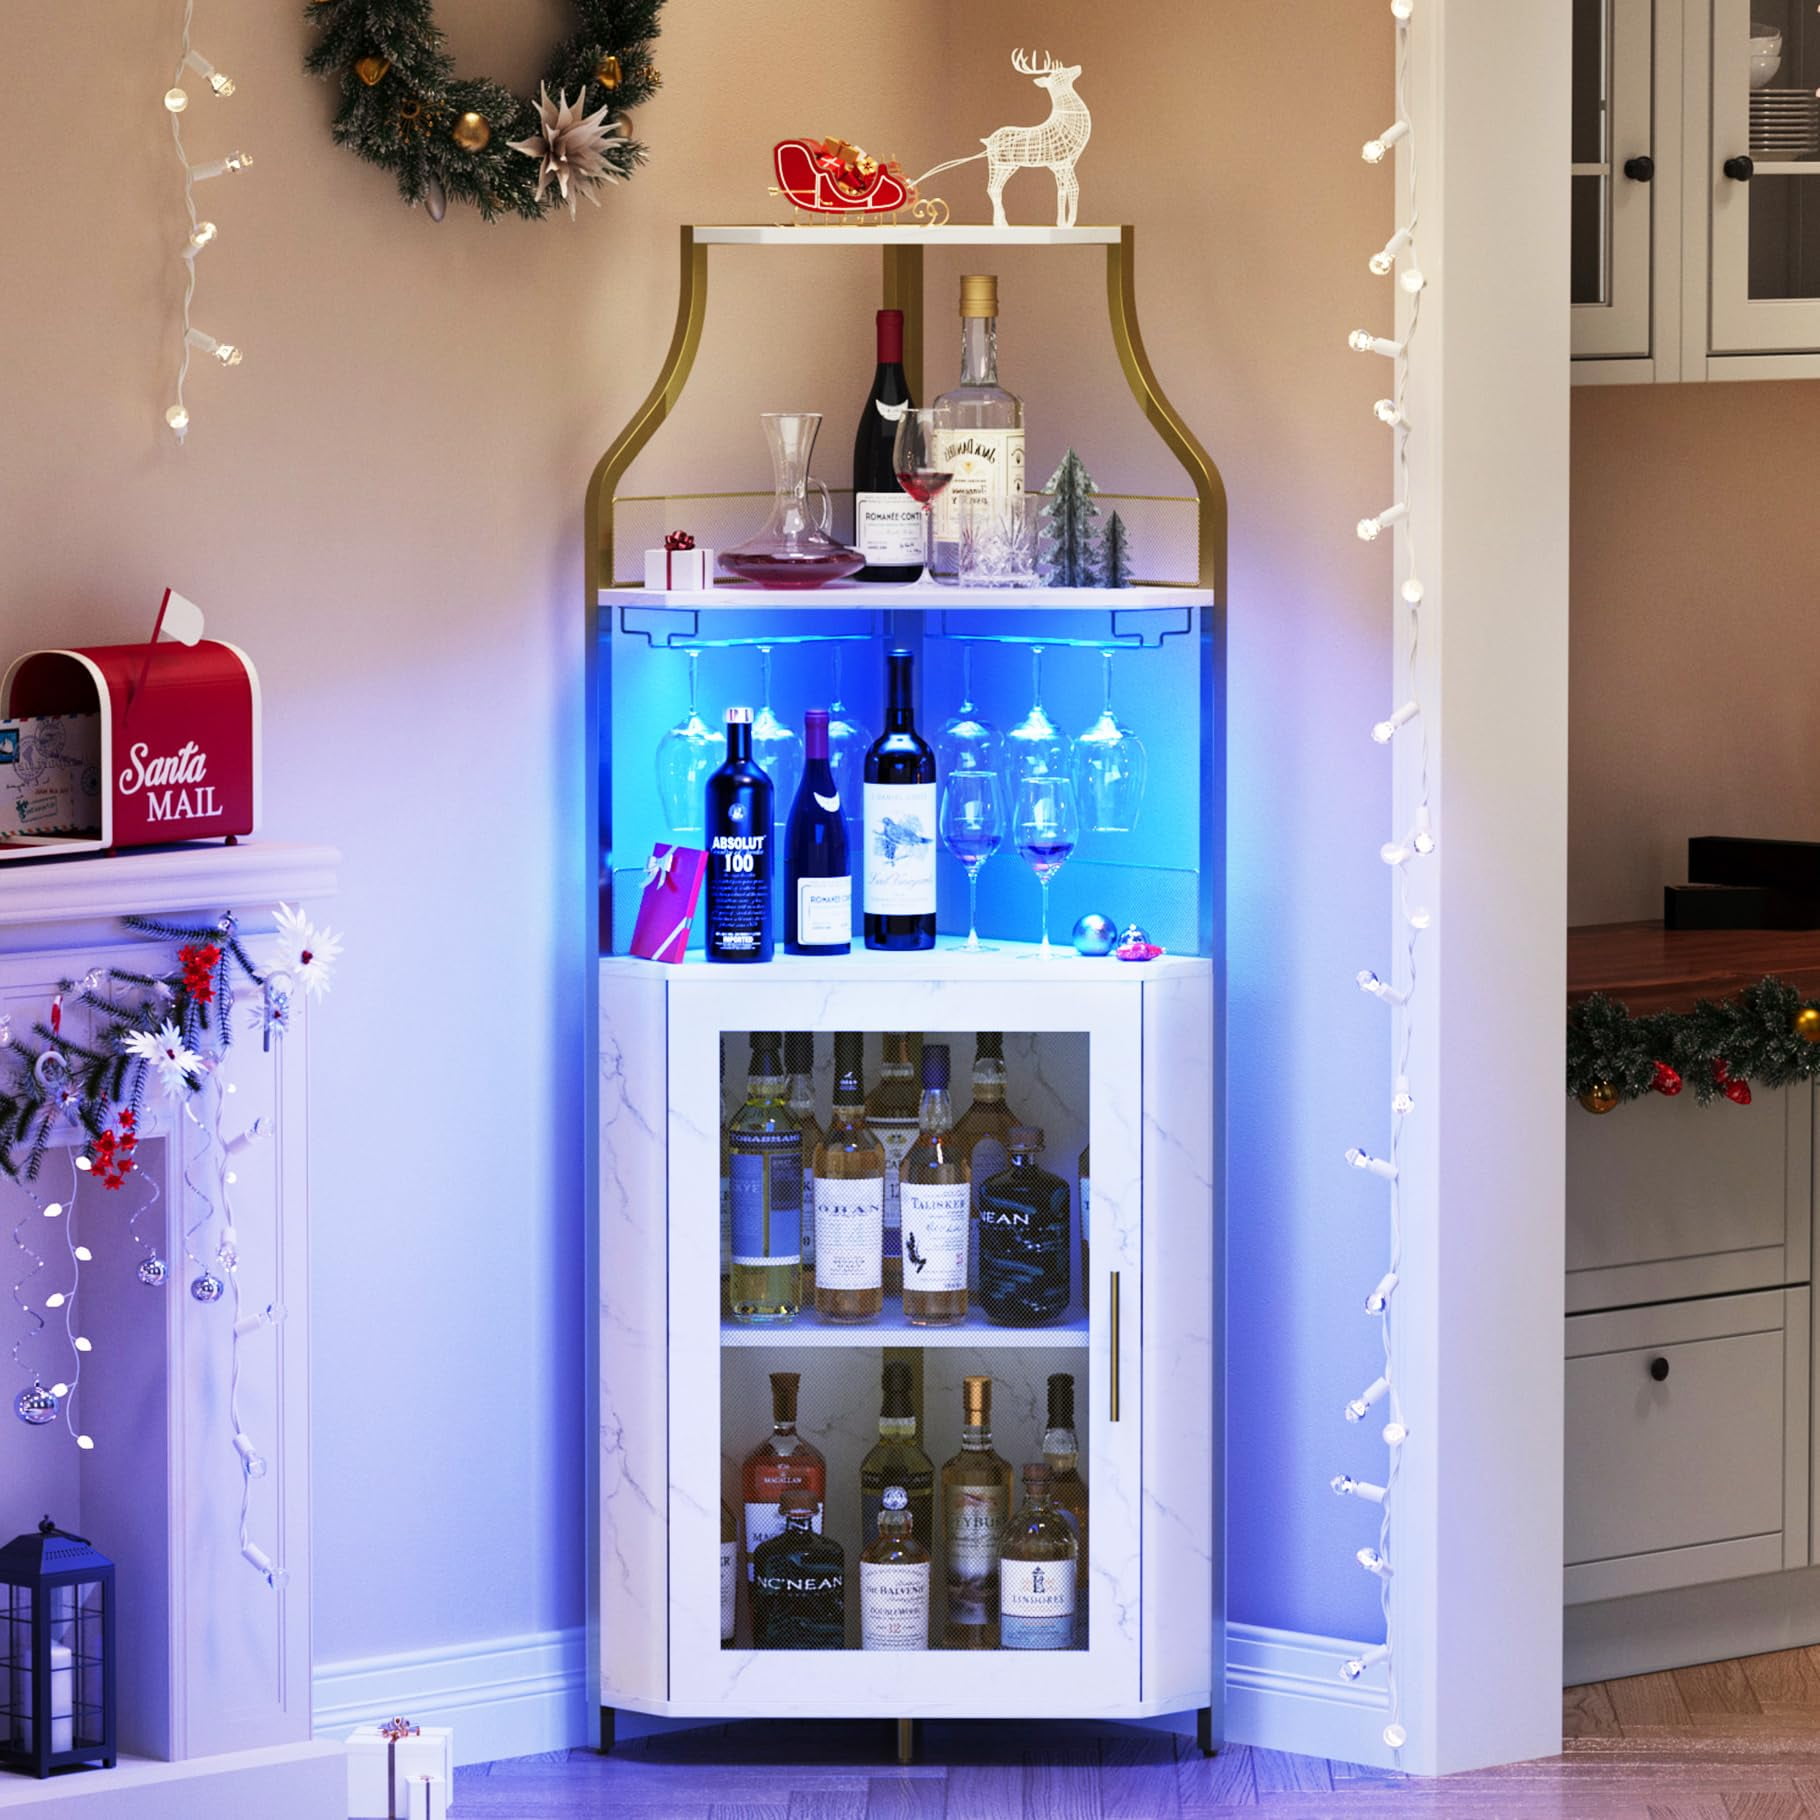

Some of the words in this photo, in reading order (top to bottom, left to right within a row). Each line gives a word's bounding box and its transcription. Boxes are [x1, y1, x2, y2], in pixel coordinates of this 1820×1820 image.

[118, 740, 207, 795] Santa
[146, 786, 223, 822] MAIL
[712, 836, 764, 850] ABSOLUT
[725, 854, 754, 873] 100
